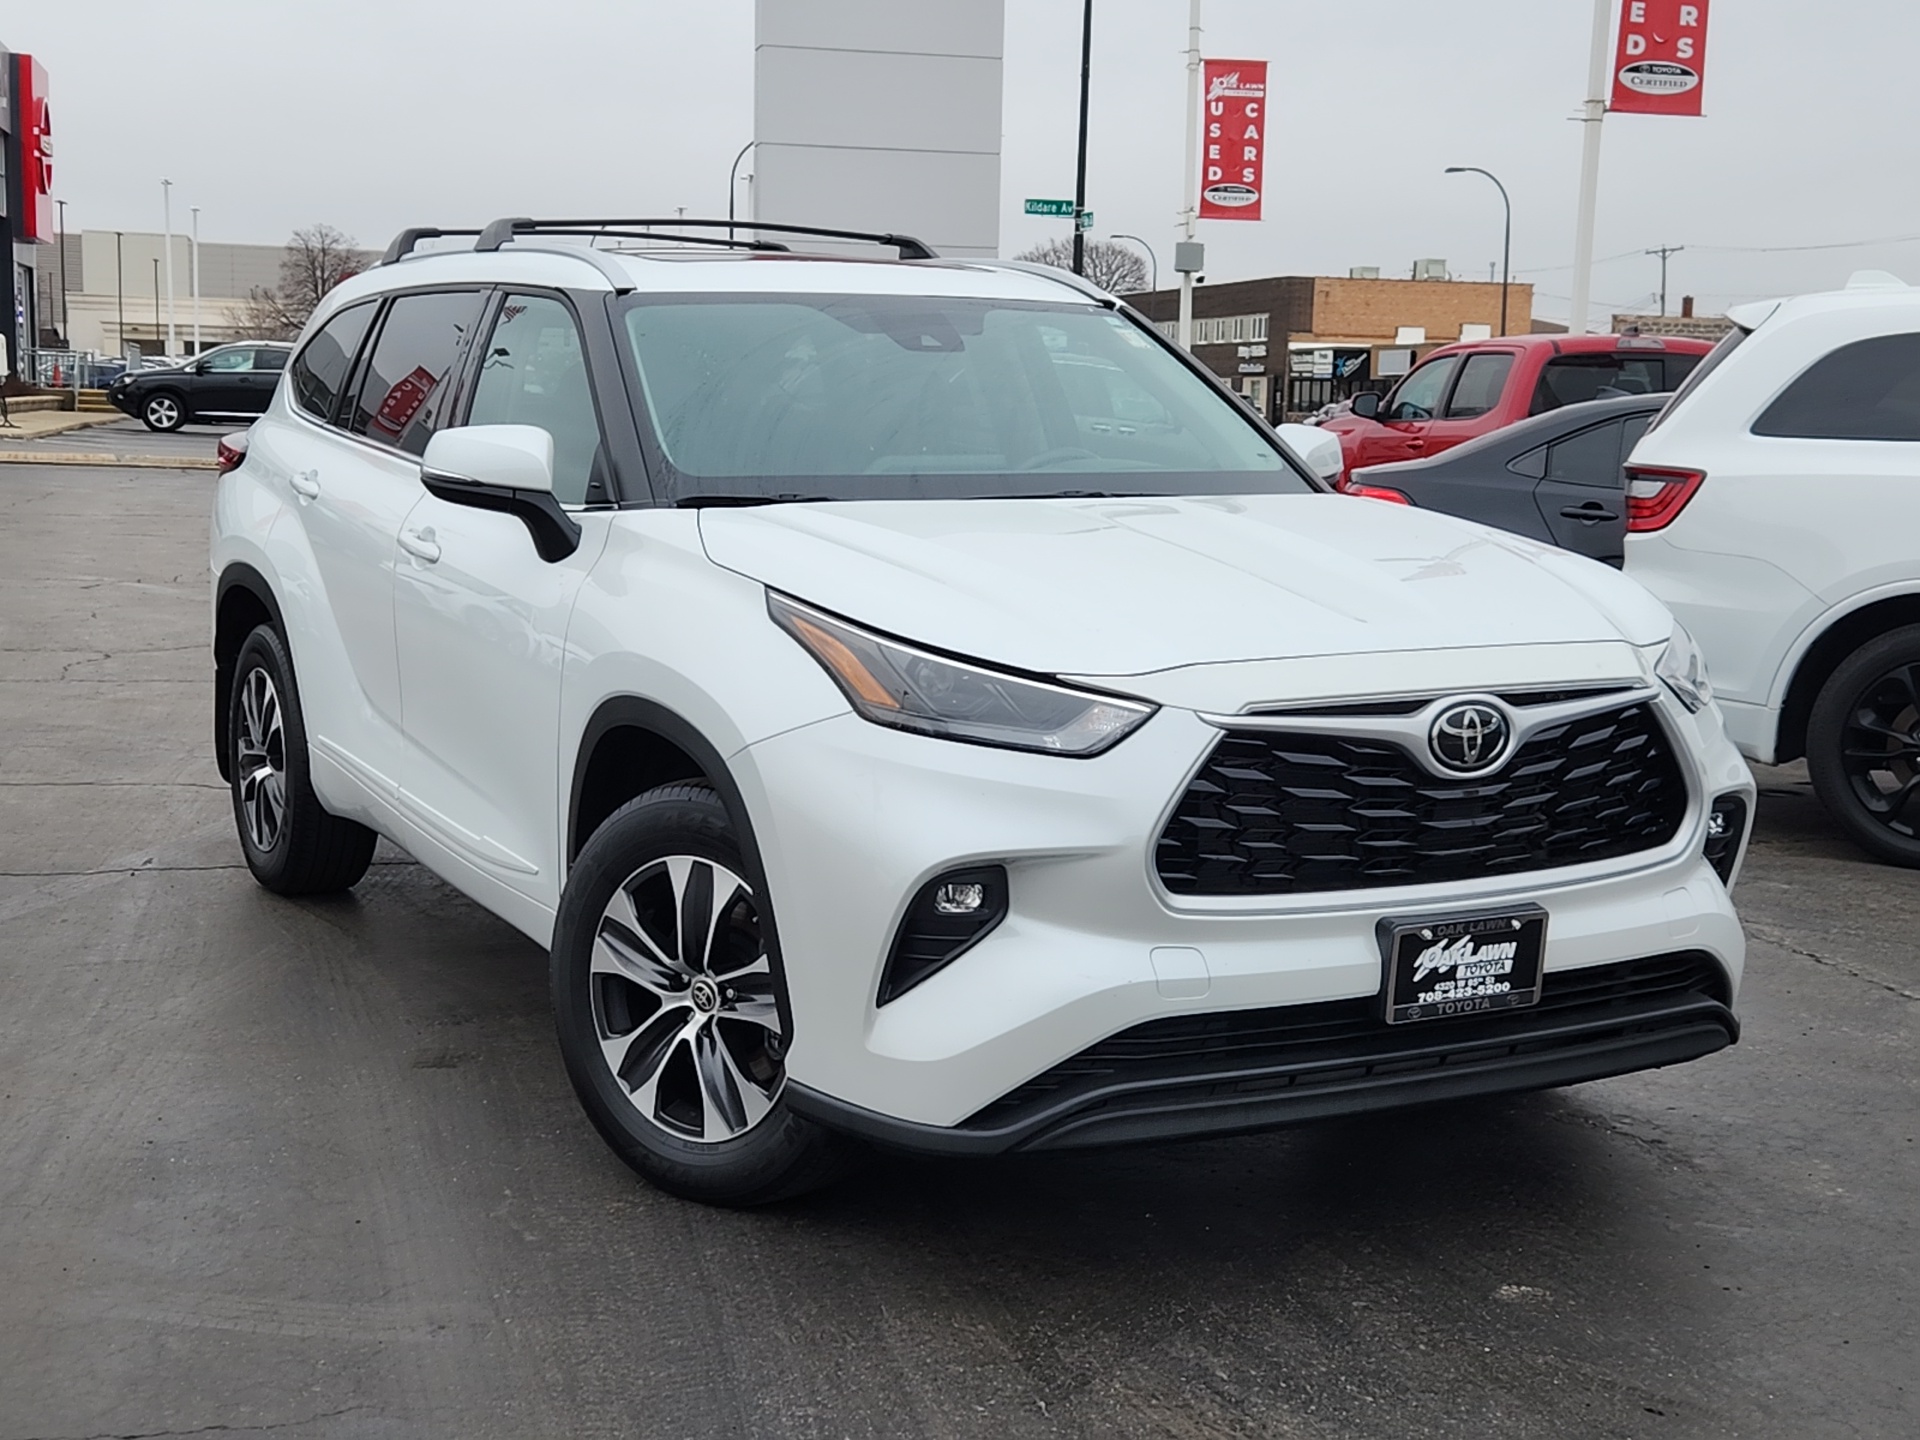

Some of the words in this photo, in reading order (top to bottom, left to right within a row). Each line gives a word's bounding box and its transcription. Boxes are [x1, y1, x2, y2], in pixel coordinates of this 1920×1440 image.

[1626, 0, 1646, 56] ED
[1676, 4, 1698, 59] RS
[1652, 66, 1681, 74] TOYOTA
[1207, 101, 1223, 181] USED
[1242, 102, 1259, 183] CARS
[1026, 201, 1058, 213] Kildare
[1436, 923, 1464, 936] OAK
[1468, 919, 1508, 932] LAWN
[1464, 961, 1505, 976] TOYOTA
[1416, 981, 1511, 1003] 708-423-5200
[1437, 997, 1490, 1015] TOYOTA
